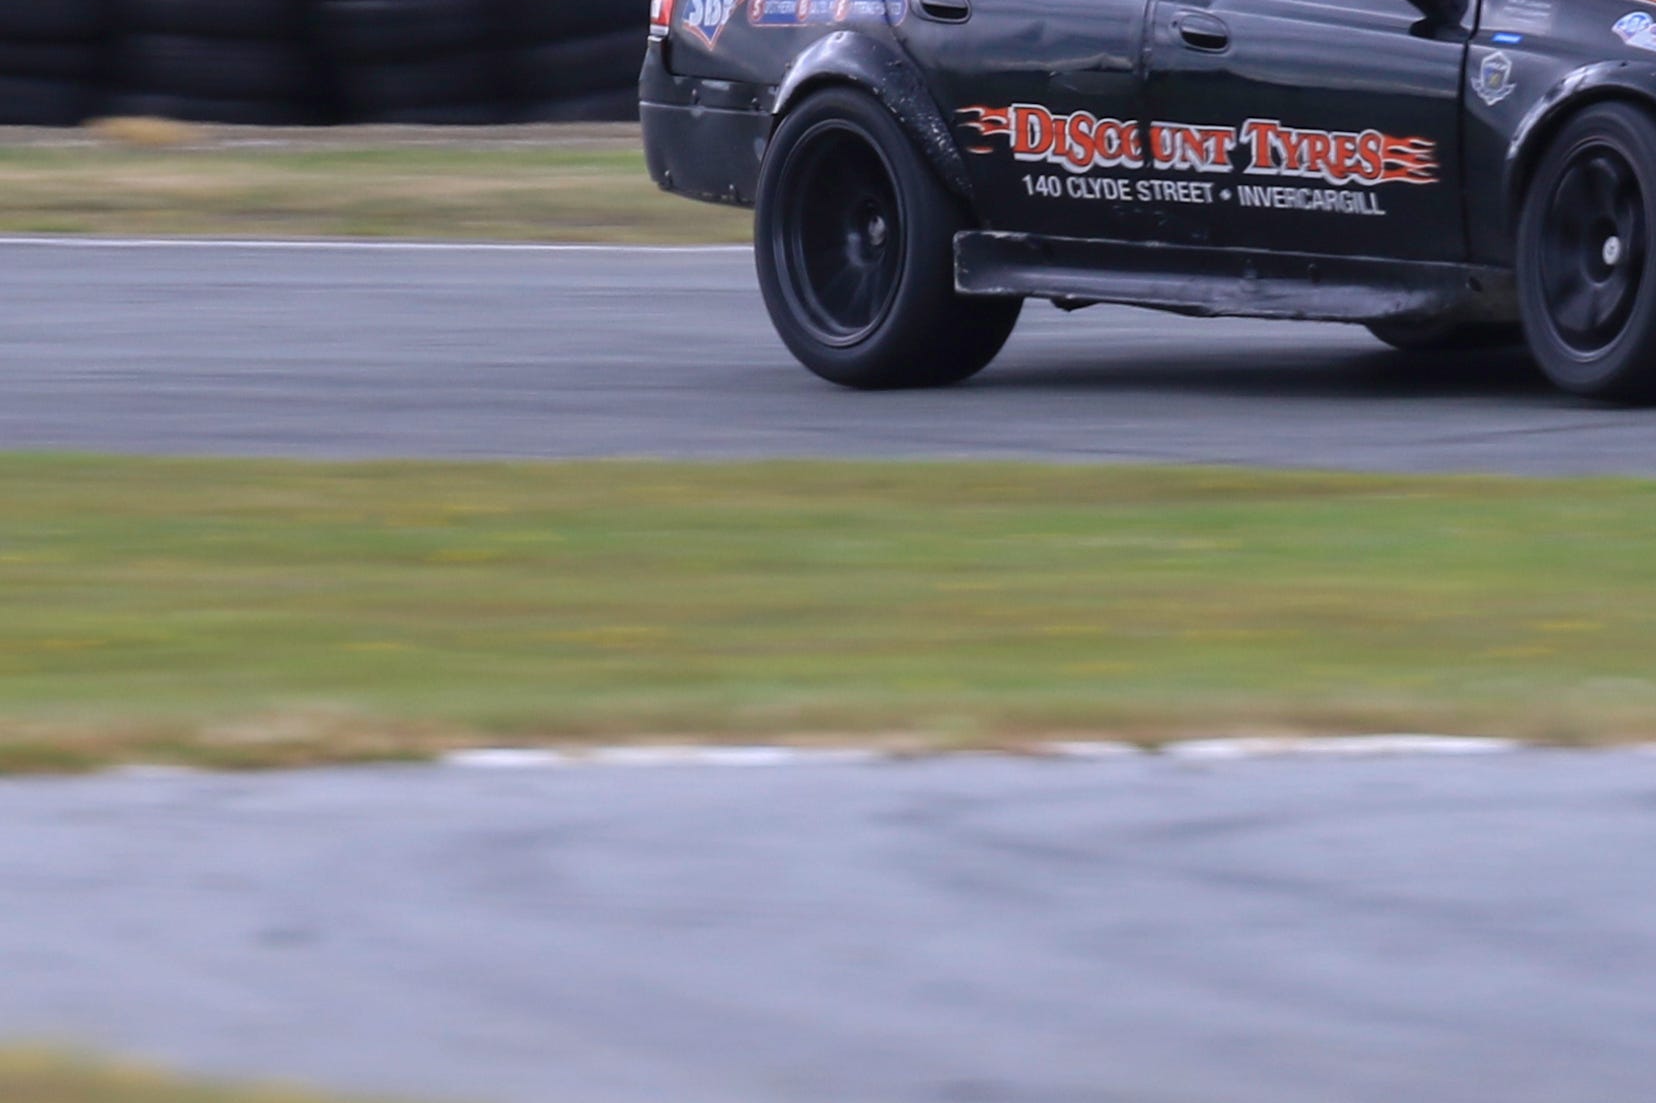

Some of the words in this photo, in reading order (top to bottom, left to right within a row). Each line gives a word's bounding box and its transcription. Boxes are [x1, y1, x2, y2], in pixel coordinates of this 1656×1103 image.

[1010, 103, 1239, 174] DISCOUNT
[1239, 118, 1385, 185] TYRES
[1022, 174, 1062, 198] 140
[1067, 177, 1133, 201] CLYDE
[1136, 180, 1214, 205] STREET
[1237, 185, 1387, 216] INVERCARGILL
